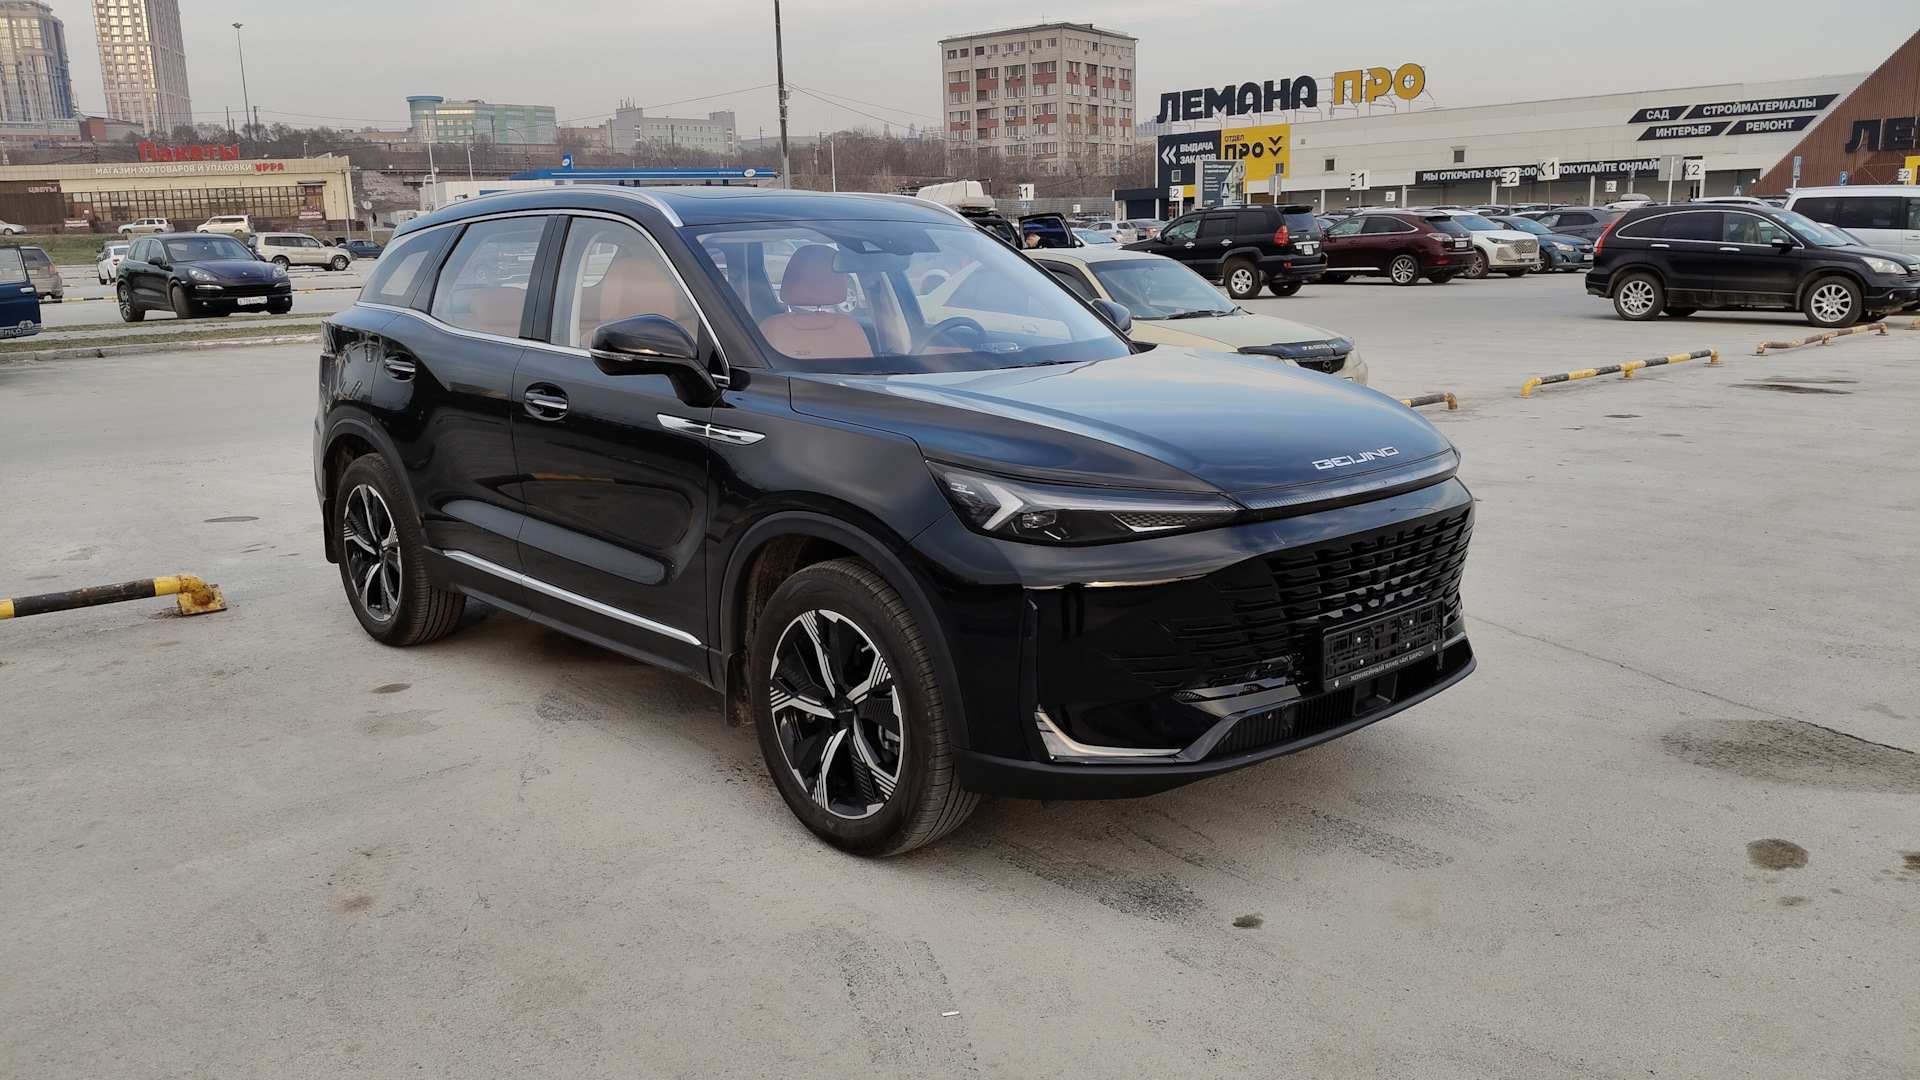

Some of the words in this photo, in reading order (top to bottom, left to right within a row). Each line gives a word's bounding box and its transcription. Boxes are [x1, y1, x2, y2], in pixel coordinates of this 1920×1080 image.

[1156, 75, 1318, 124] ЛЕМАНА
[1333, 62, 1426, 106] ПРО
[1646, 109, 1670, 120] САД
[1703, 98, 1817, 116] СТРОЙМАТЕРИАЛЫ
[1655, 125, 1712, 138] ИНТЕРЬЕР
[1745, 119, 1795, 132] РЕМОНТ
[1844, 116, 1920, 153] ЛЕ
[1180, 141, 1214, 153] ВЫДАЧА
[1224, 134, 1245, 142] ОТДЕЛ
[139, 141, 240, 162] Пакеты
[1180, 153, 1217, 165] ЗАКАЗОВ
[1224, 141, 1265, 161] ПРО
[95, 167, 137, 175] МАГАЗИН
[139, 165, 195, 174] ХОЗТОВАРОВ
[205, 164, 252, 172] УПАКОВКИ
[1423, 172, 1438, 181] МЫ
[1440, 169, 1484, 180] ОТКРЫТЫ
[1559, 161, 1617, 175] ПОКУПАЙТЕ
[1619, 158, 1660, 172] ОНЛАЙ
[1312, 446, 1400, 471] BEIJING
[1350, 663, 1385, 681] ХОККЕЙНЫЙ
